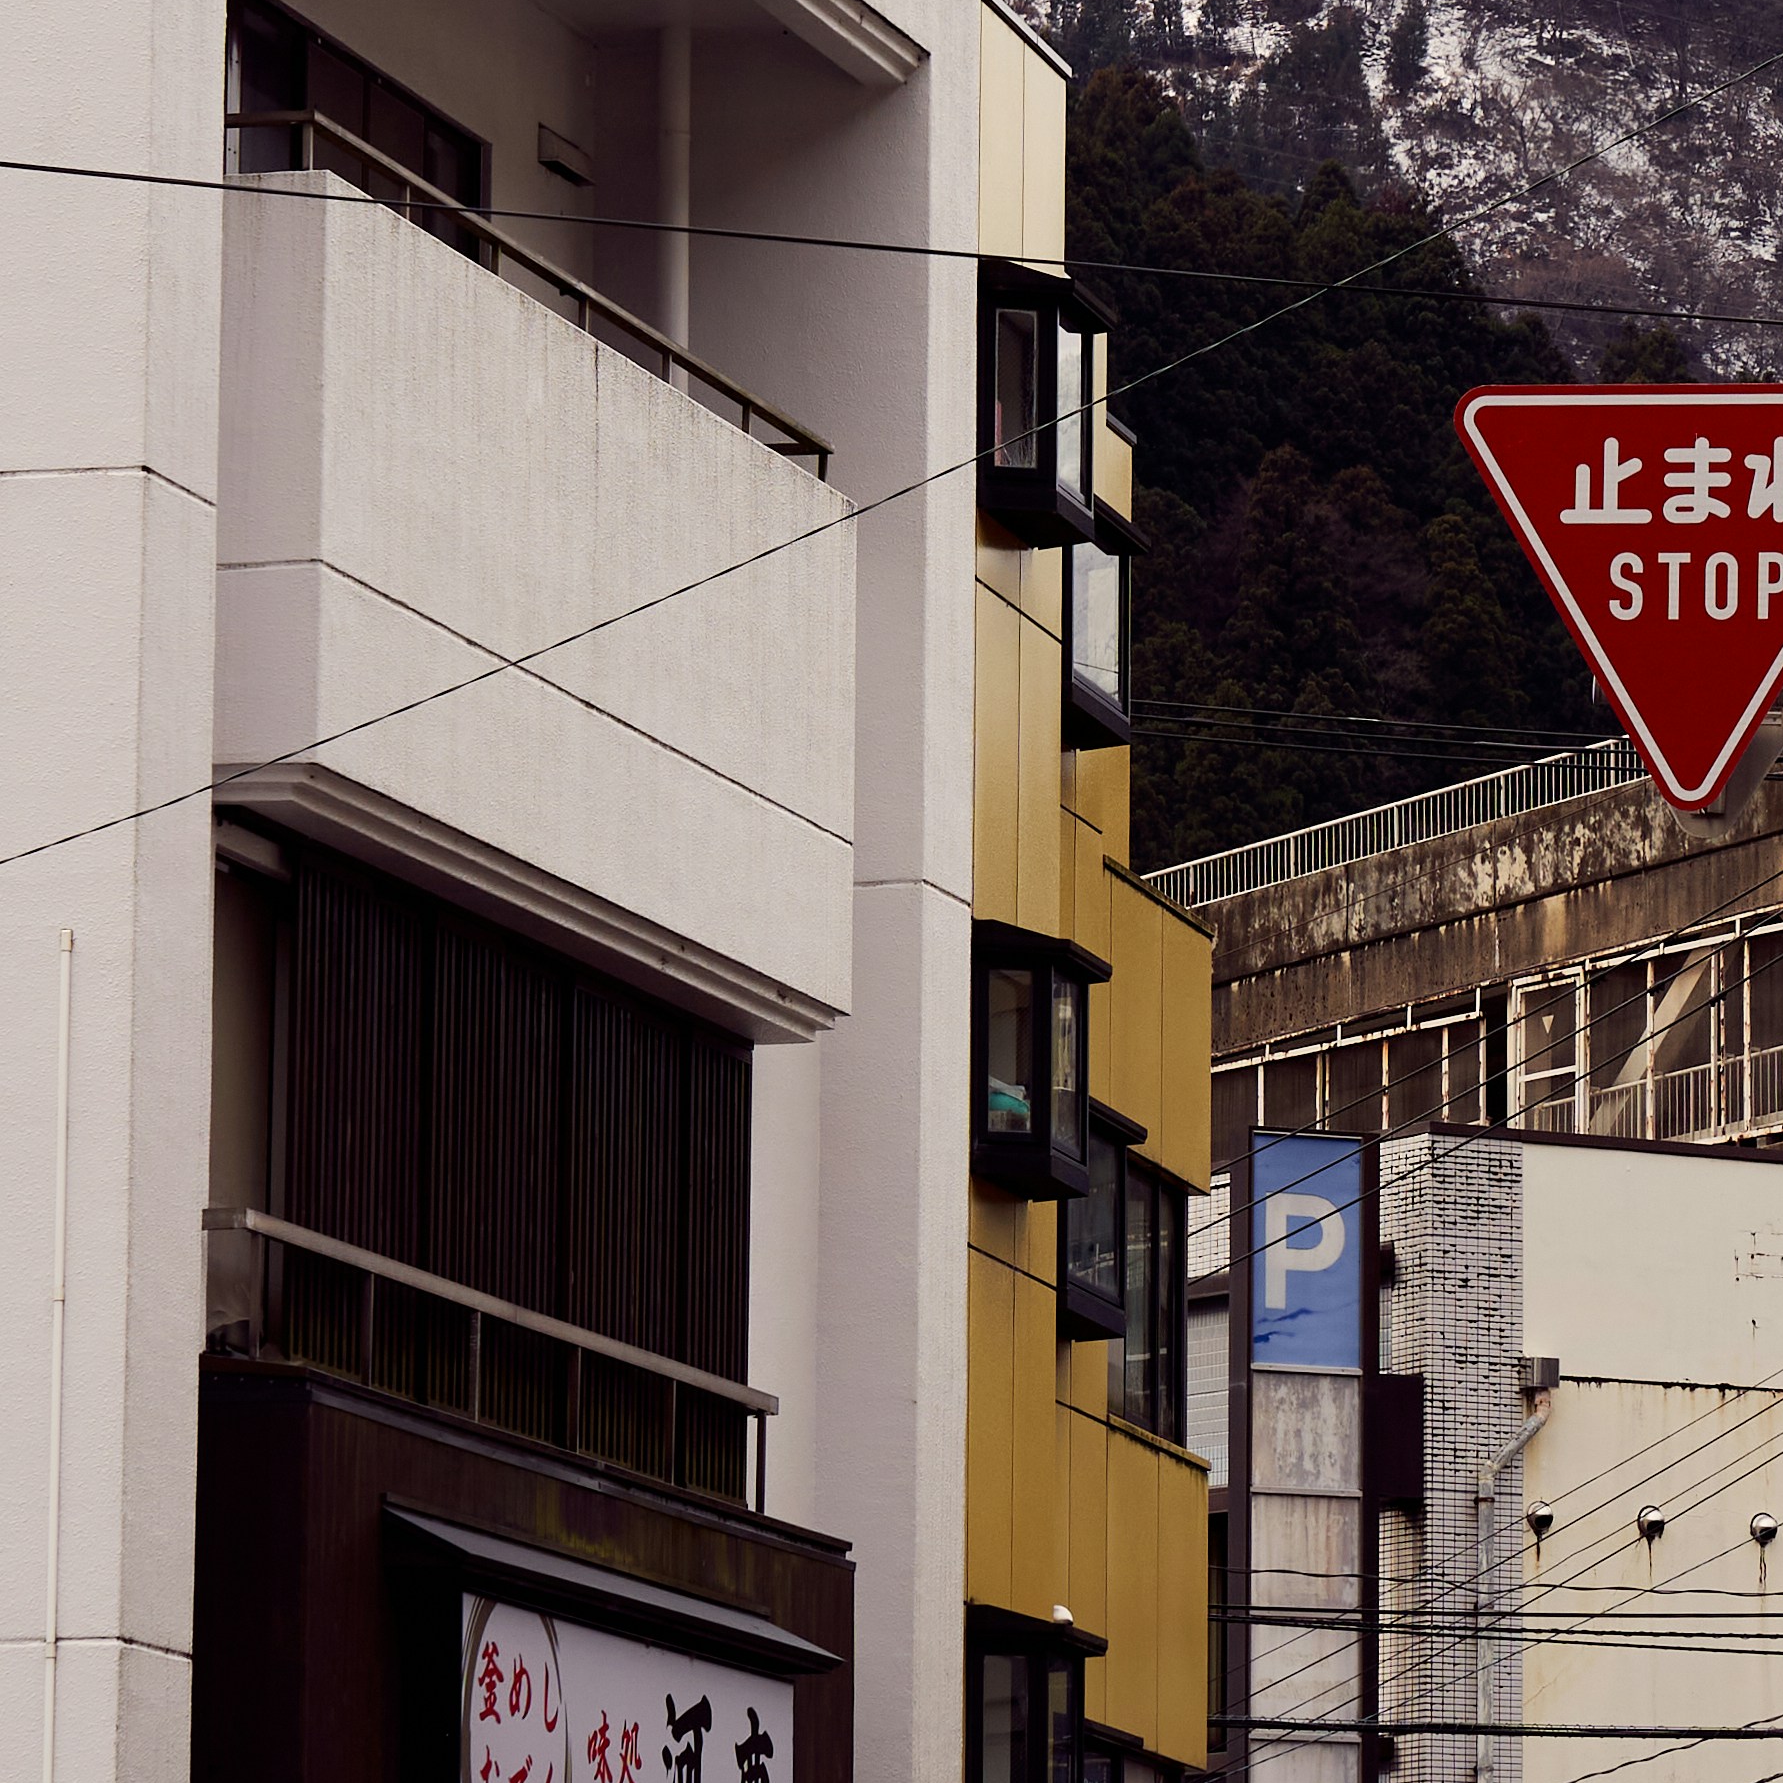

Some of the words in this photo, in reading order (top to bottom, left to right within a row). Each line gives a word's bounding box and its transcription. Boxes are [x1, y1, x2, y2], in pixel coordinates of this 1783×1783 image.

[1264, 1191, 1347, 1310] P
[477, 1641, 559, 1733] 釜めし
